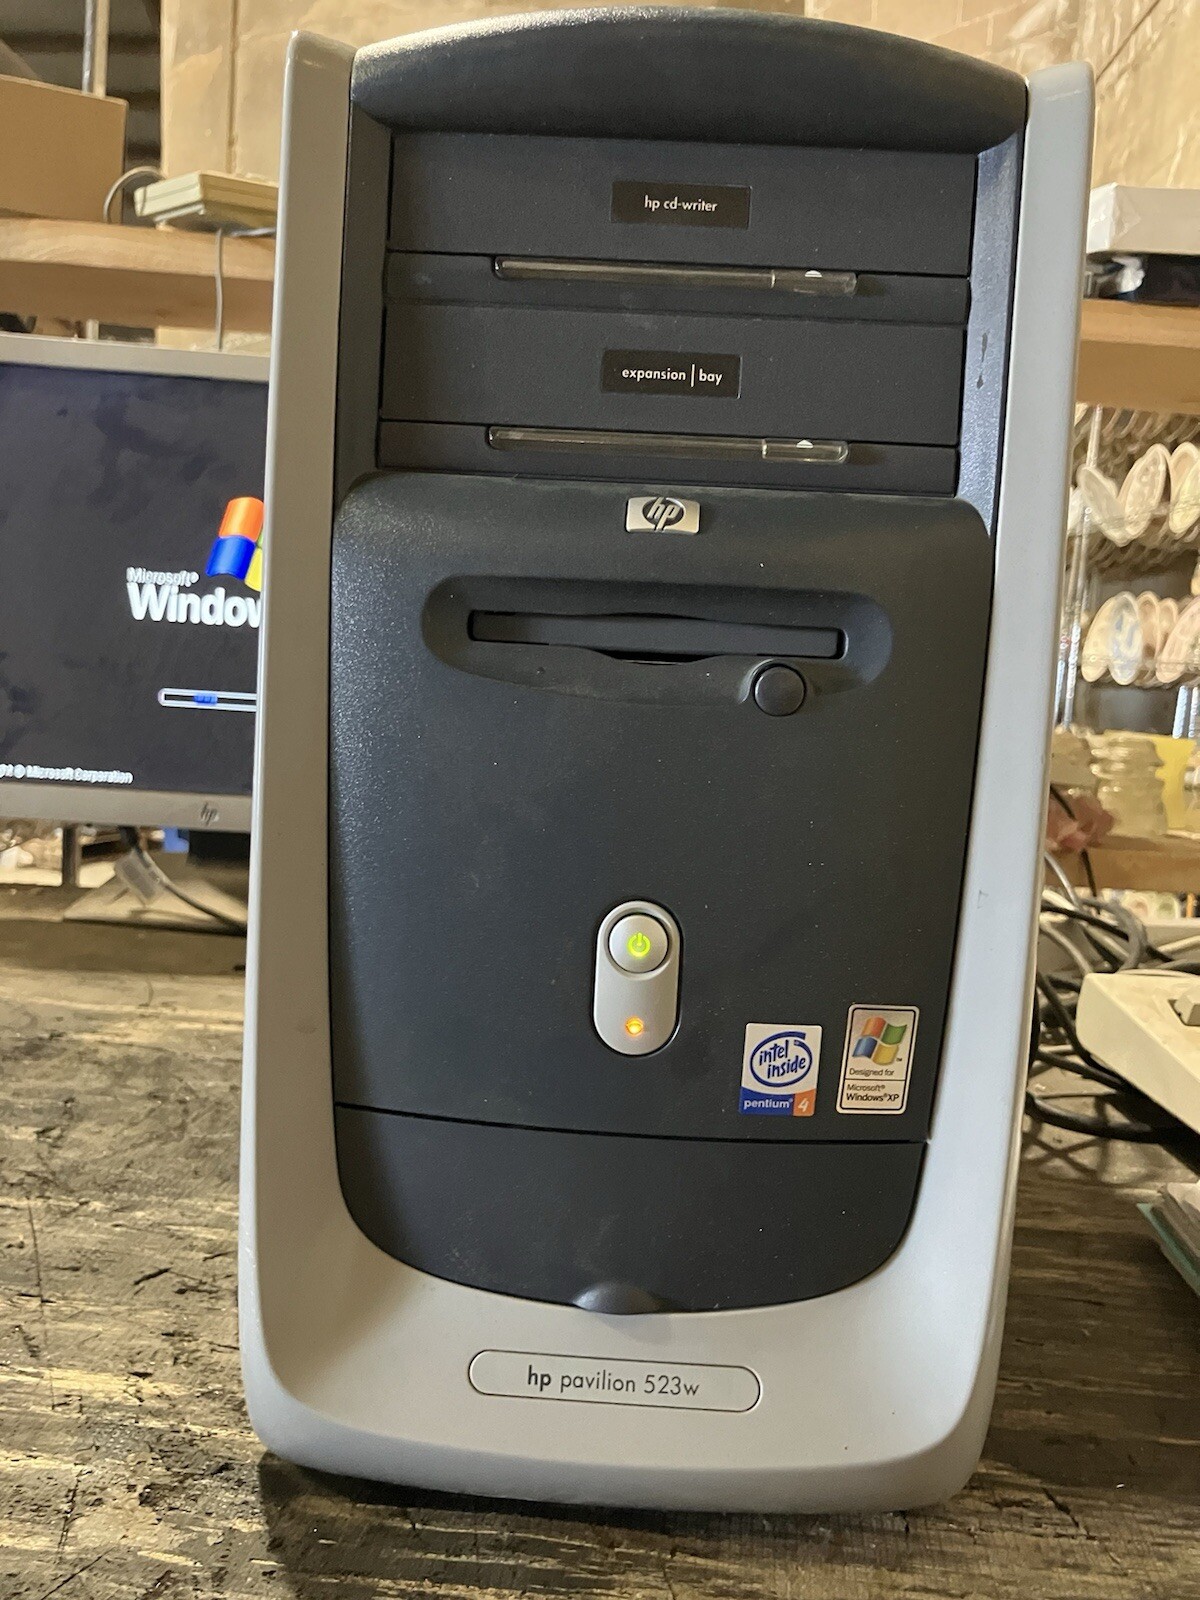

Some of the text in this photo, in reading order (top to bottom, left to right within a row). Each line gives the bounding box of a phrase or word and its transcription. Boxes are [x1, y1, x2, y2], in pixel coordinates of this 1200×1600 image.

[644, 194, 718, 212] hp cd-writer
[621, 366, 723, 386] expansion bay
[126, 582, 260, 628] Windo
[26, 765, 74, 780] Microsoft
[74, 767, 133, 784] Corporation
[200, 801, 219, 827] hp
[759, 1039, 789, 1066] intel
[767, 1055, 806, 1079] inside
[849, 1067, 895, 1077] Designed for
[798, 1098, 809, 1113] 4
[527, 1364, 700, 1396] hp pavilion 523w
